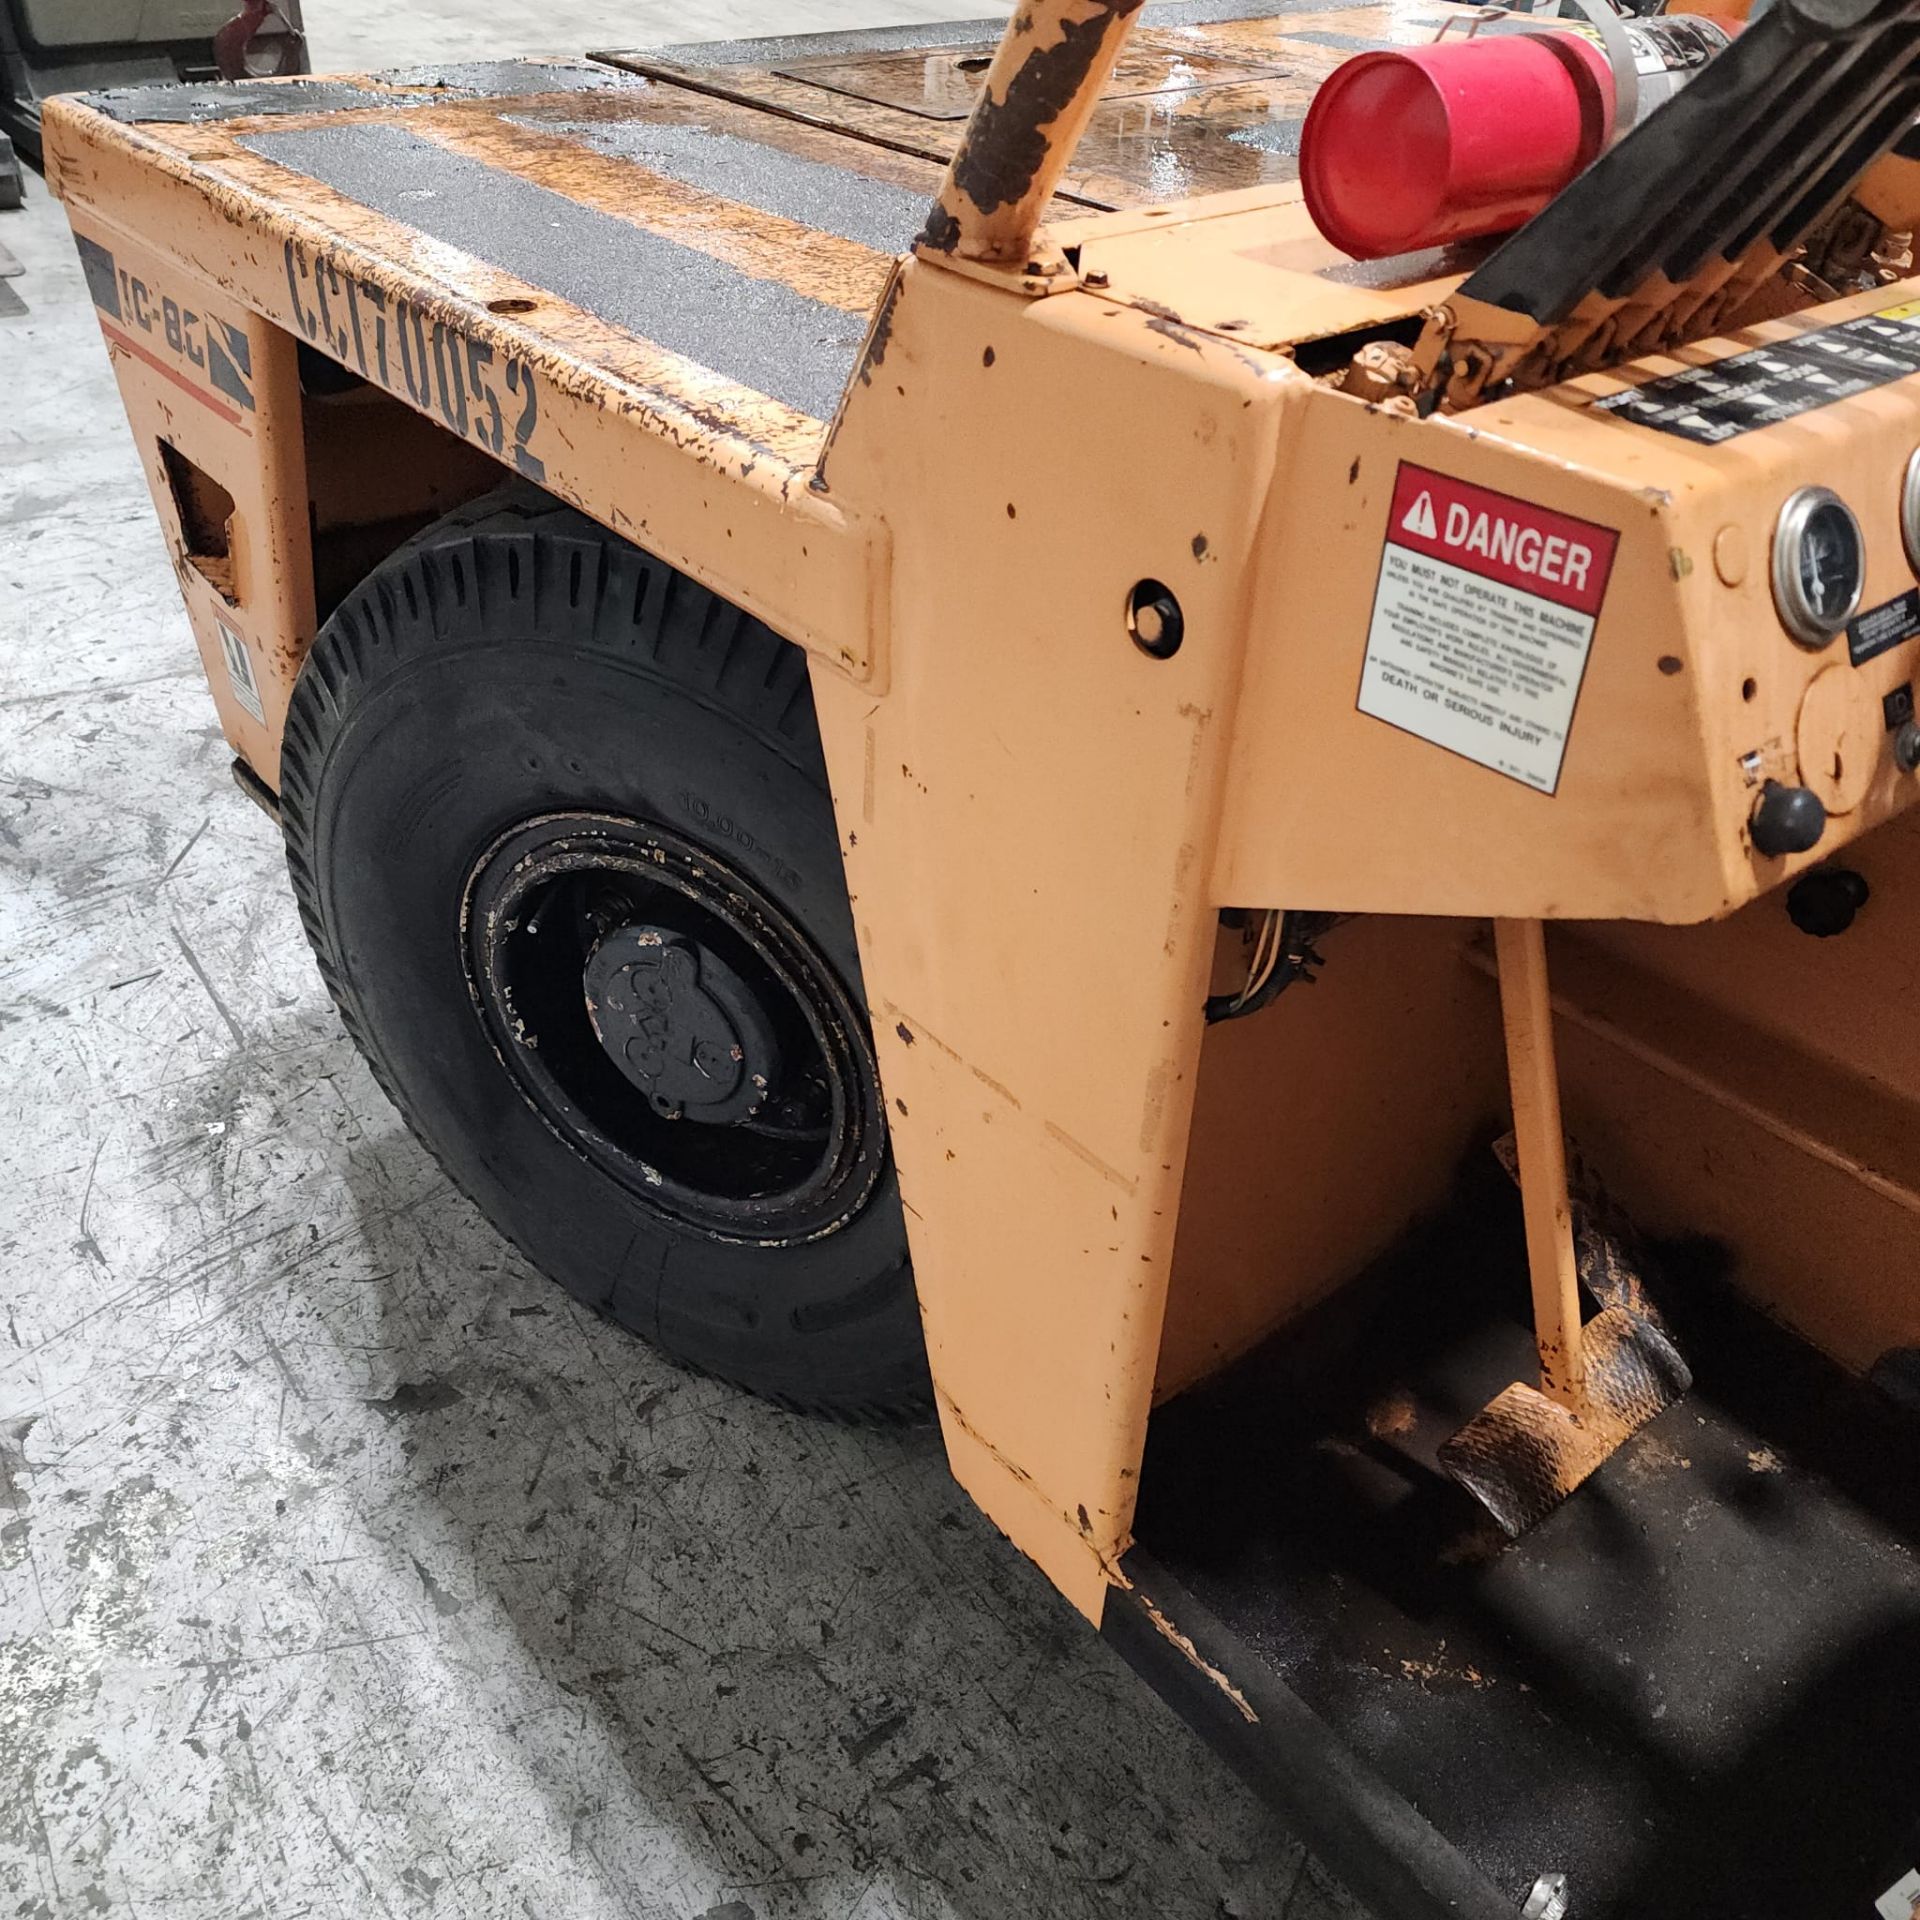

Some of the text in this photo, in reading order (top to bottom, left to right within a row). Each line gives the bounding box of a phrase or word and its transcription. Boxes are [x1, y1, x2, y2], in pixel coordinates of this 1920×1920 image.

[1442, 500, 1594, 593] DANGER
[1388, 554, 1585, 637] YOU MUST NOT OPERATE THIS MACHINE
[1381, 670, 1542, 748] DEATH OR SERIOUS INJURY
